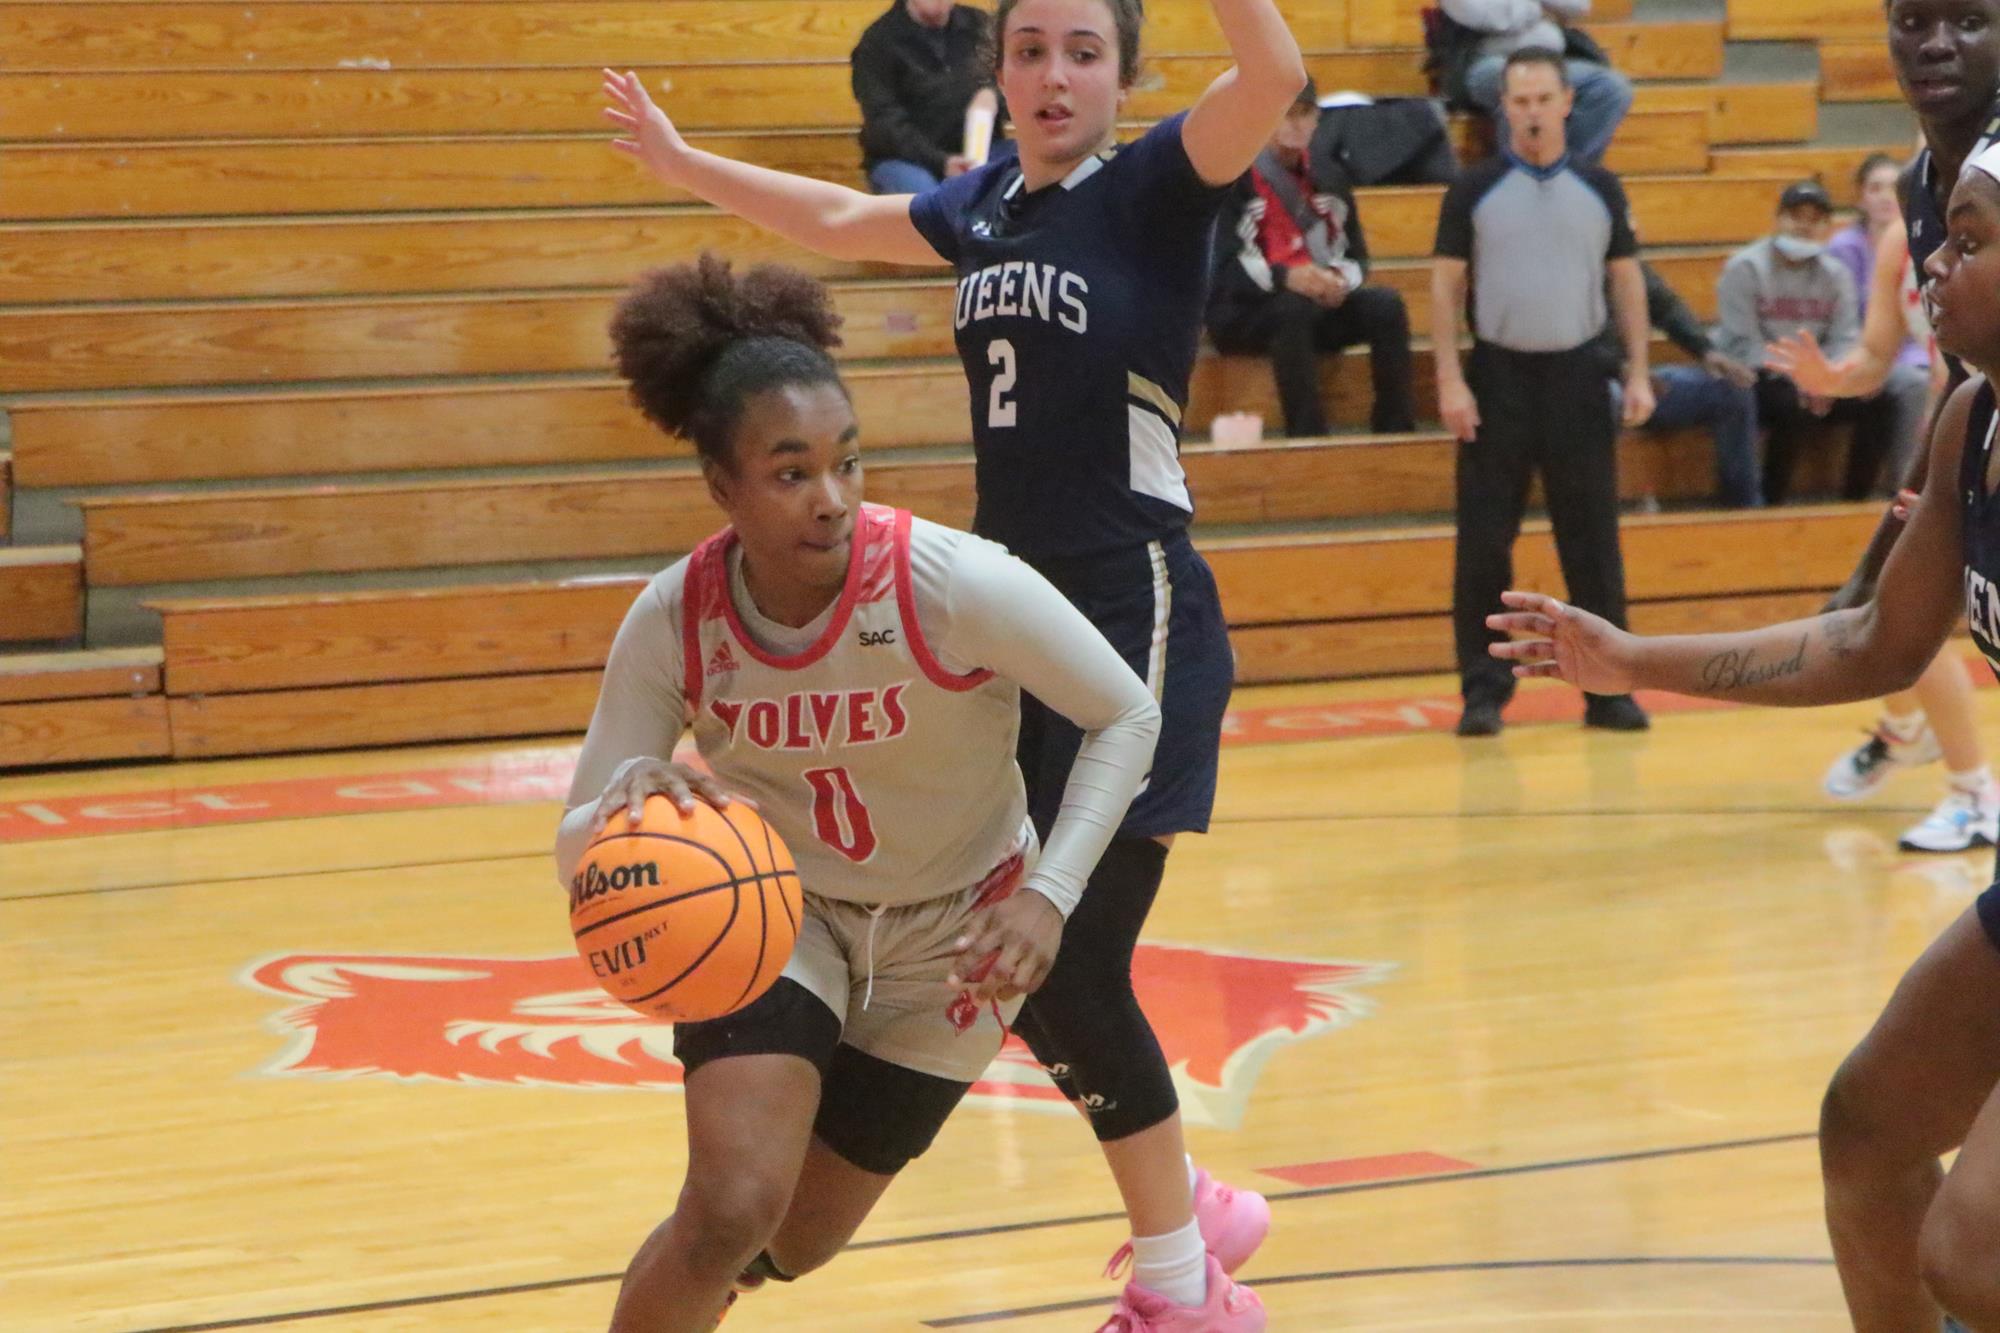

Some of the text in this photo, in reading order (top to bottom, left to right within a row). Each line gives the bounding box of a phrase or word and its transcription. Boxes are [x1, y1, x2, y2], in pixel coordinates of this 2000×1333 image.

[954, 261, 1088, 335] UEENS
[987, 338, 1017, 428] 2
[858, 629, 896, 647] SAC
[1699, 632, 1809, 692] Blessed
[802, 766, 878, 863] 0
[570, 860, 661, 914] ilson
